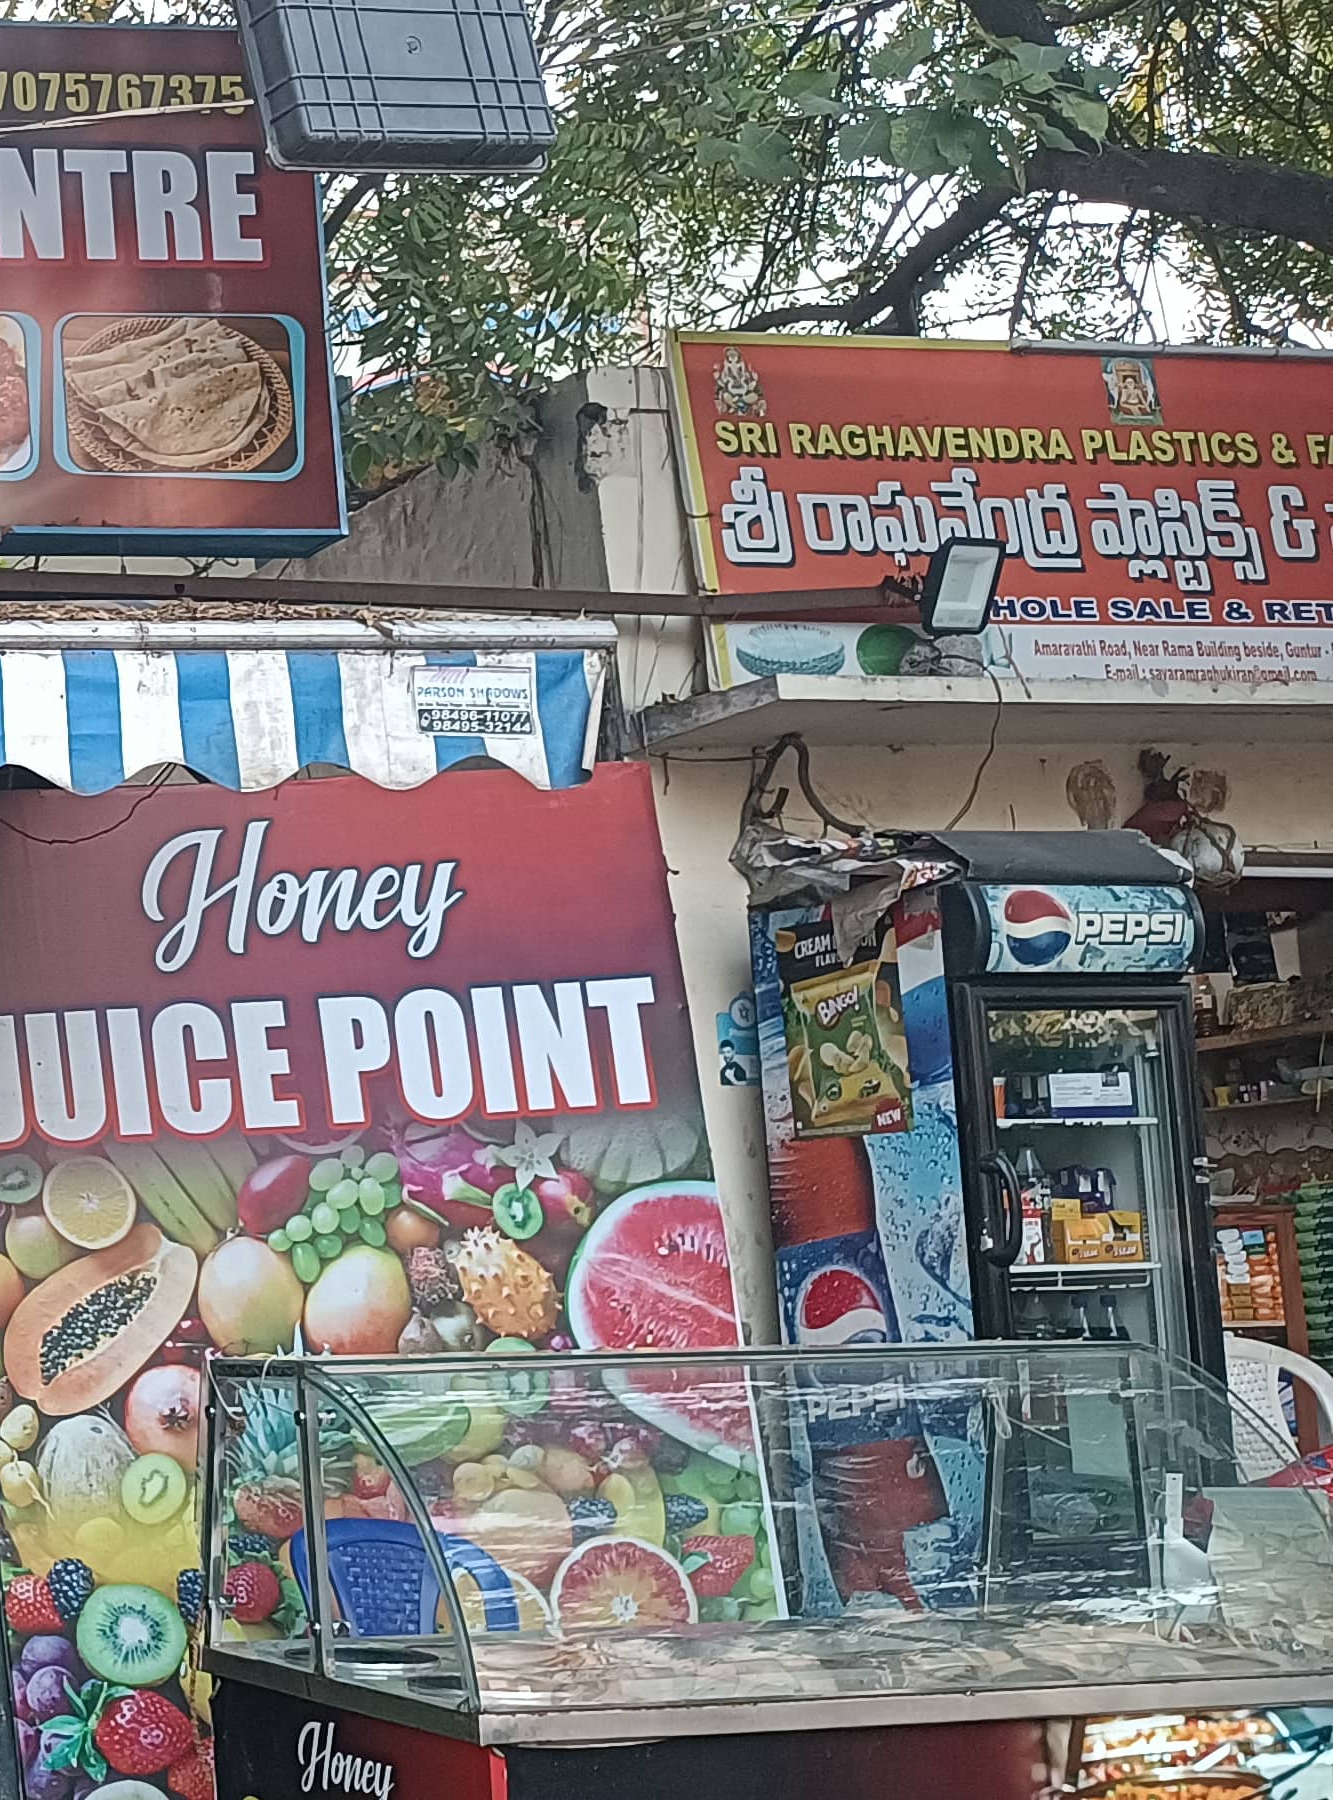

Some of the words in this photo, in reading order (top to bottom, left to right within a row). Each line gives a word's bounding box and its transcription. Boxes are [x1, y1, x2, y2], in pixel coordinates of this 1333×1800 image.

[716, 421, 778, 455] SRI
[789, 423, 1075, 462] RAGHAVENDRA
[1081, 429, 1259, 465] PLASTICS
[1270, 433, 1297, 465] &
[721, 466, 793, 565] శ్రీ
[993, 598, 1098, 620] HOLE
[1110, 599, 1210, 621] SALE
[1224, 601, 1253, 621] &
[1034, 639, 1095, 657] Amaravathi
[1100, 640, 1131, 660] Road,
[1134, 640, 1159, 657] Near
[1162, 641, 1193, 657] Rama
[1197, 641, 1241, 661] Building
[1243, 641, 1284, 662] beside,
[1286, 643, 1321, 659] Guntur
[417, 686, 464, 698] PARSON
[469, 687, 528, 700] SHADOWS
[432, 709, 527, 722] 98496-11077
[433, 720, 530, 733] 98495-32144
[141, 820, 463, 973] Honey
[1075, 911, 1185, 945] PEPSI
[794, 932, 832, 959] CREAM
[815, 953, 842, 968] FLAV
[318, 977, 654, 1124] POINT
[877, 1107, 902, 1127] NEW
[297, 1721, 395, 1800] Honey
